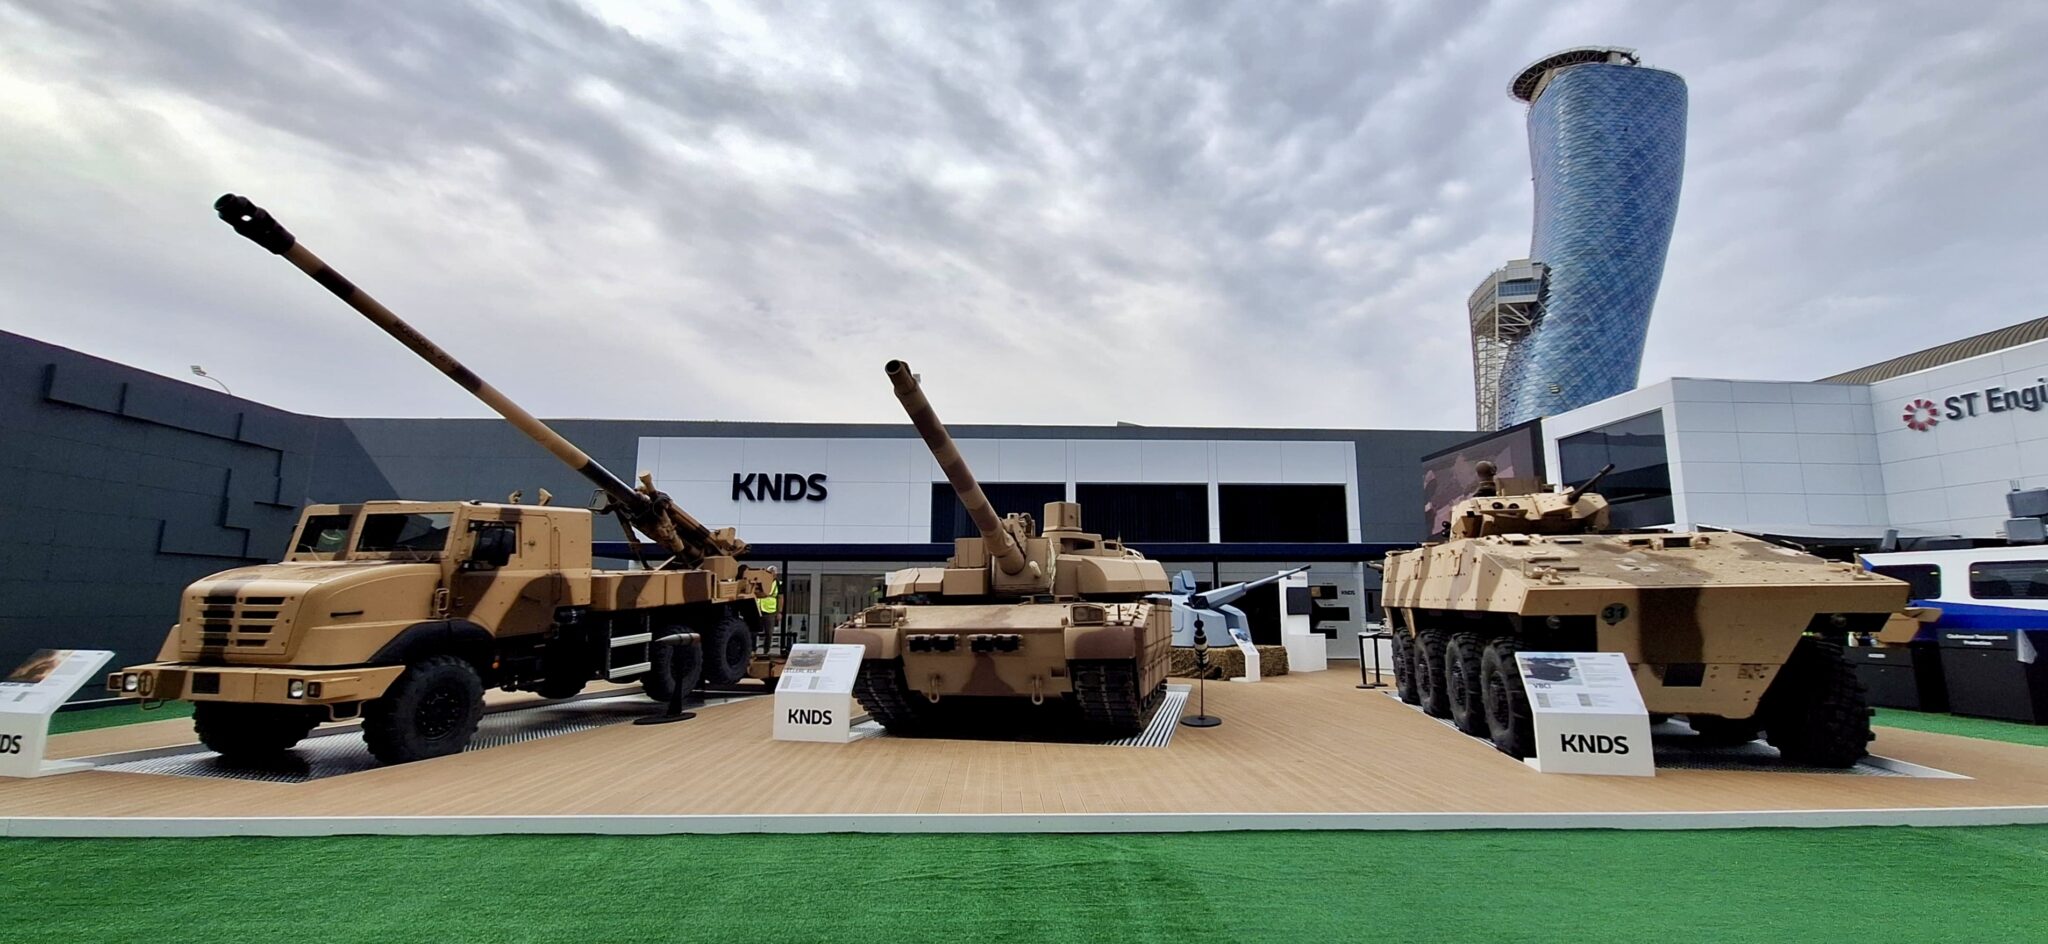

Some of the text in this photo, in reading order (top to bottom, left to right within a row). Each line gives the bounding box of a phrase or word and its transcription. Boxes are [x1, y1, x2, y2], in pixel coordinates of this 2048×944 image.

[1945, 377, 2048, 420] ST Engi
[732, 473, 828, 501] KNDS
[788, 709, 832, 725] KNDS
[0, 734, 22, 754] DS
[1561, 733, 1629, 755] KNDS
